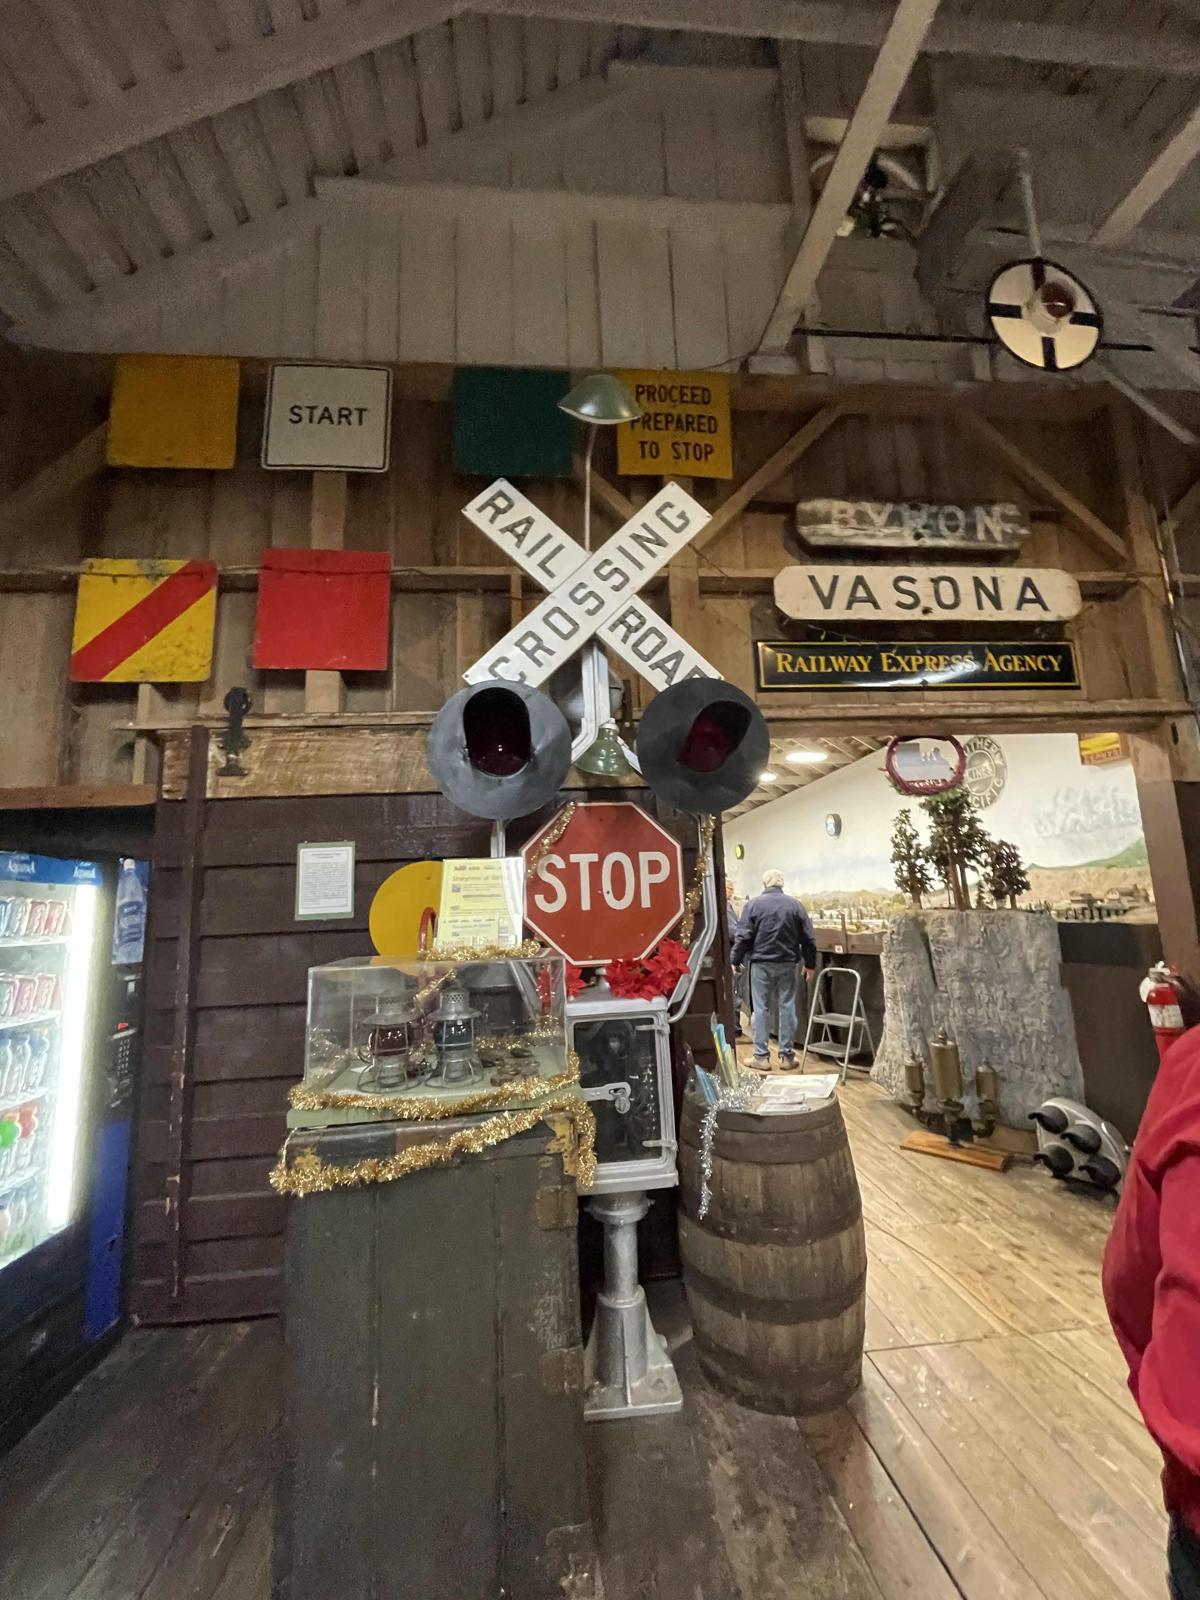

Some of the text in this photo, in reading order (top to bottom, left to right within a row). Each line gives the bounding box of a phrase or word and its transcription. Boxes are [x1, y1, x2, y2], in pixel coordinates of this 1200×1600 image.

[635, 384, 711, 405] PROCEED
[289, 405, 367, 426] START
[639, 441, 714, 461] TO STOP
[476, 489, 566, 580] RAIL
[807, 574, 1050, 611] VASONA
[534, 851, 671, 913] STOP
